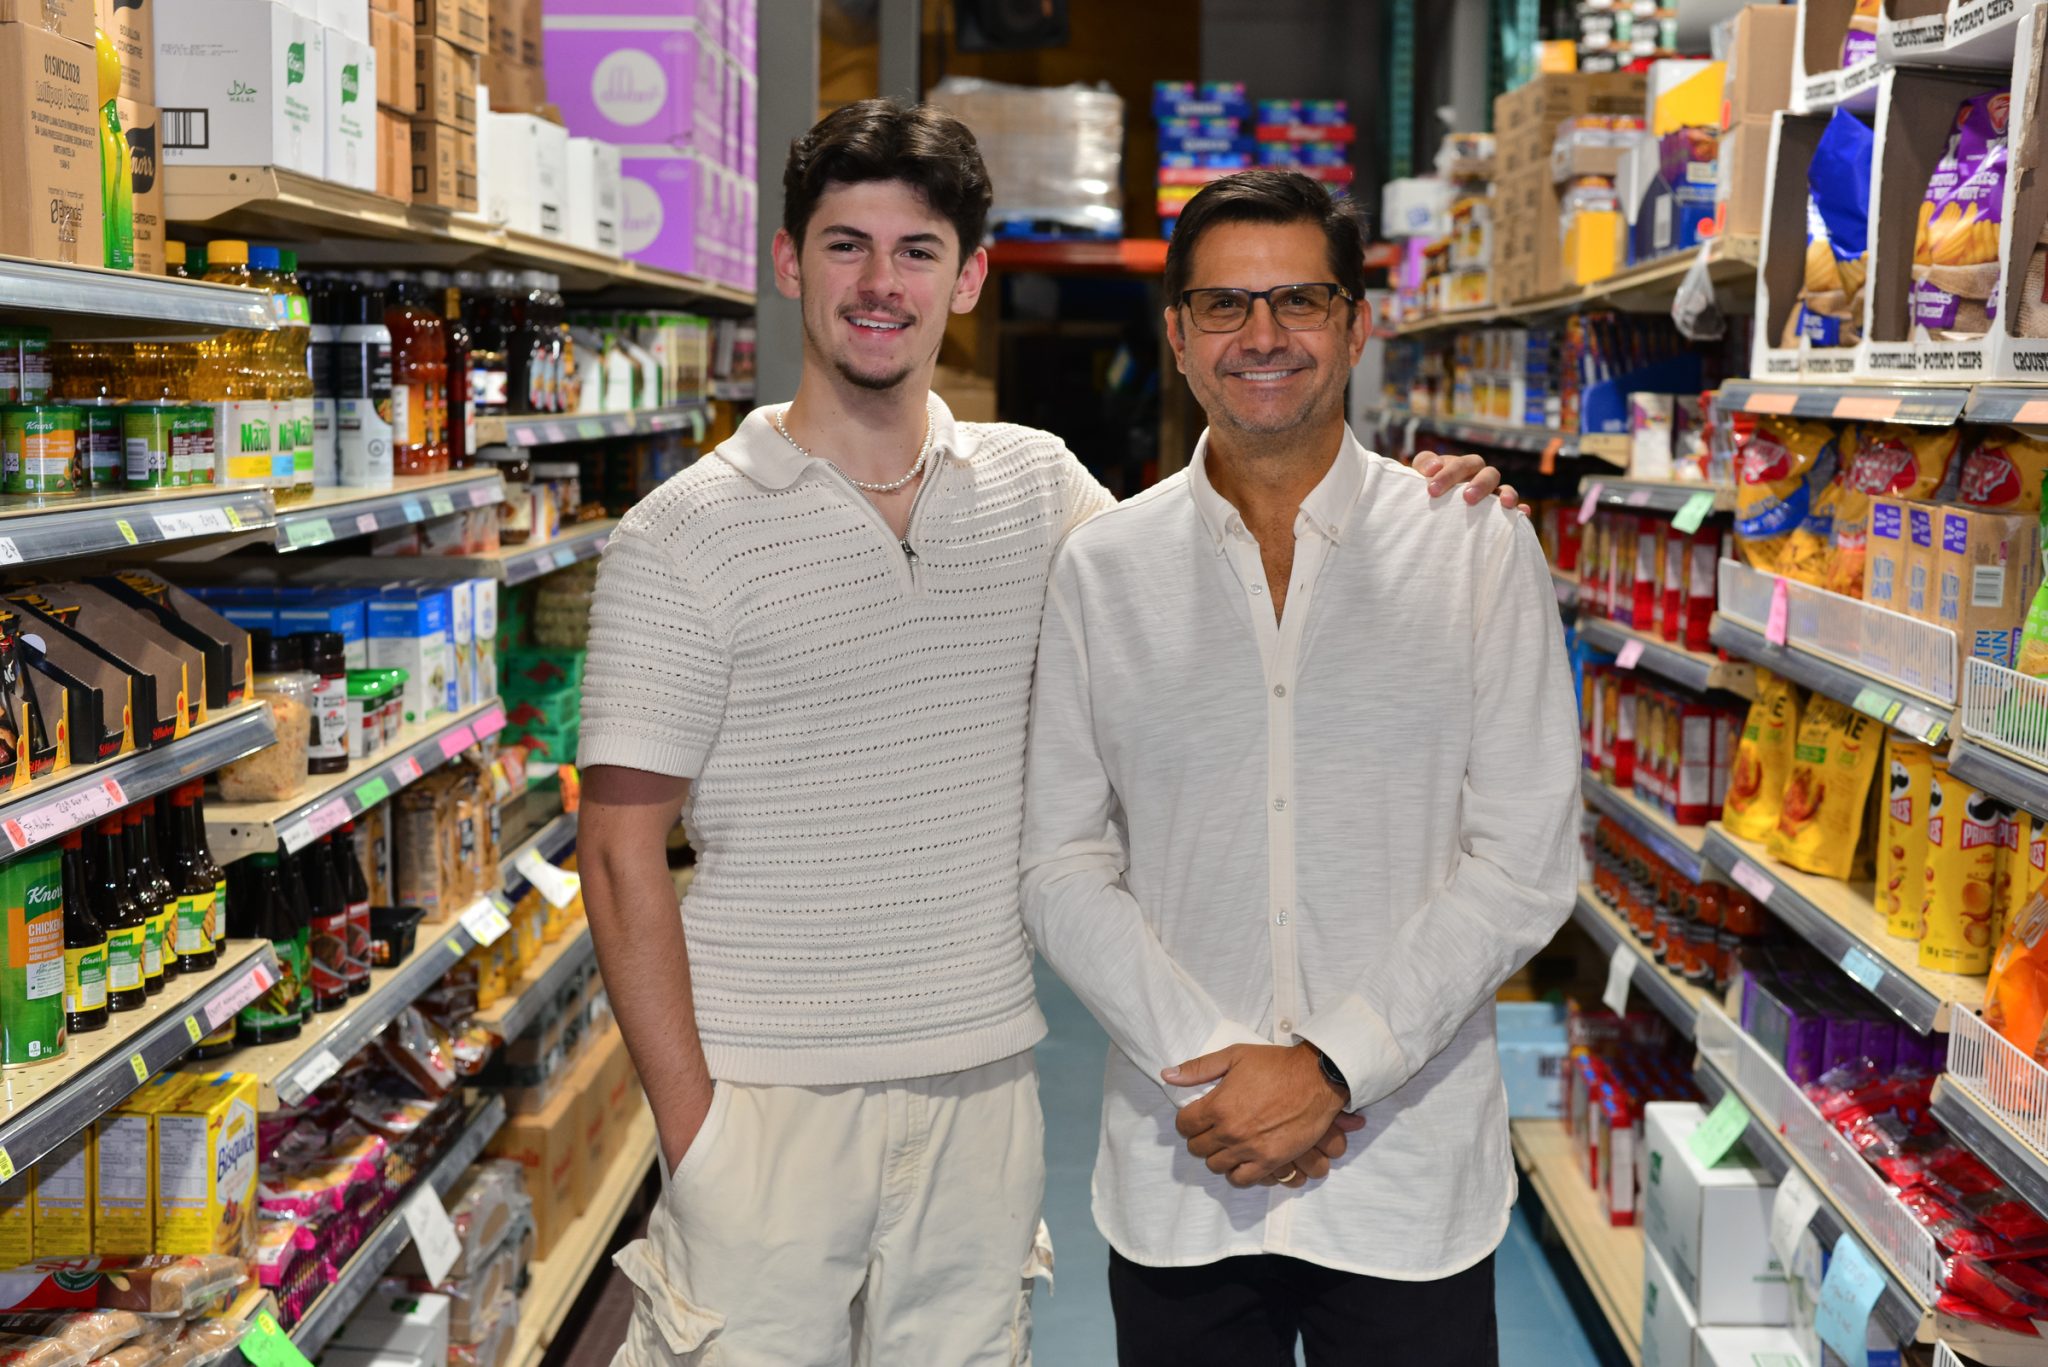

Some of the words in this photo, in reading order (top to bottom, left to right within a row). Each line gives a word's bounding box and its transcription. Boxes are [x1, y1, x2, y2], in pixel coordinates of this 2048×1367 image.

[1892, 24, 1945, 48] CROUSTILLES
[1952, 10, 1984, 37] POTATO
[1986, 0, 2014, 22] CHIPS
[1923, 352, 1955, 370] POTATO
[1957, 351, 1983, 368] CHIPS
[25, 421, 54, 431] Knorr
[216, 1130, 255, 1184] Bisquick
